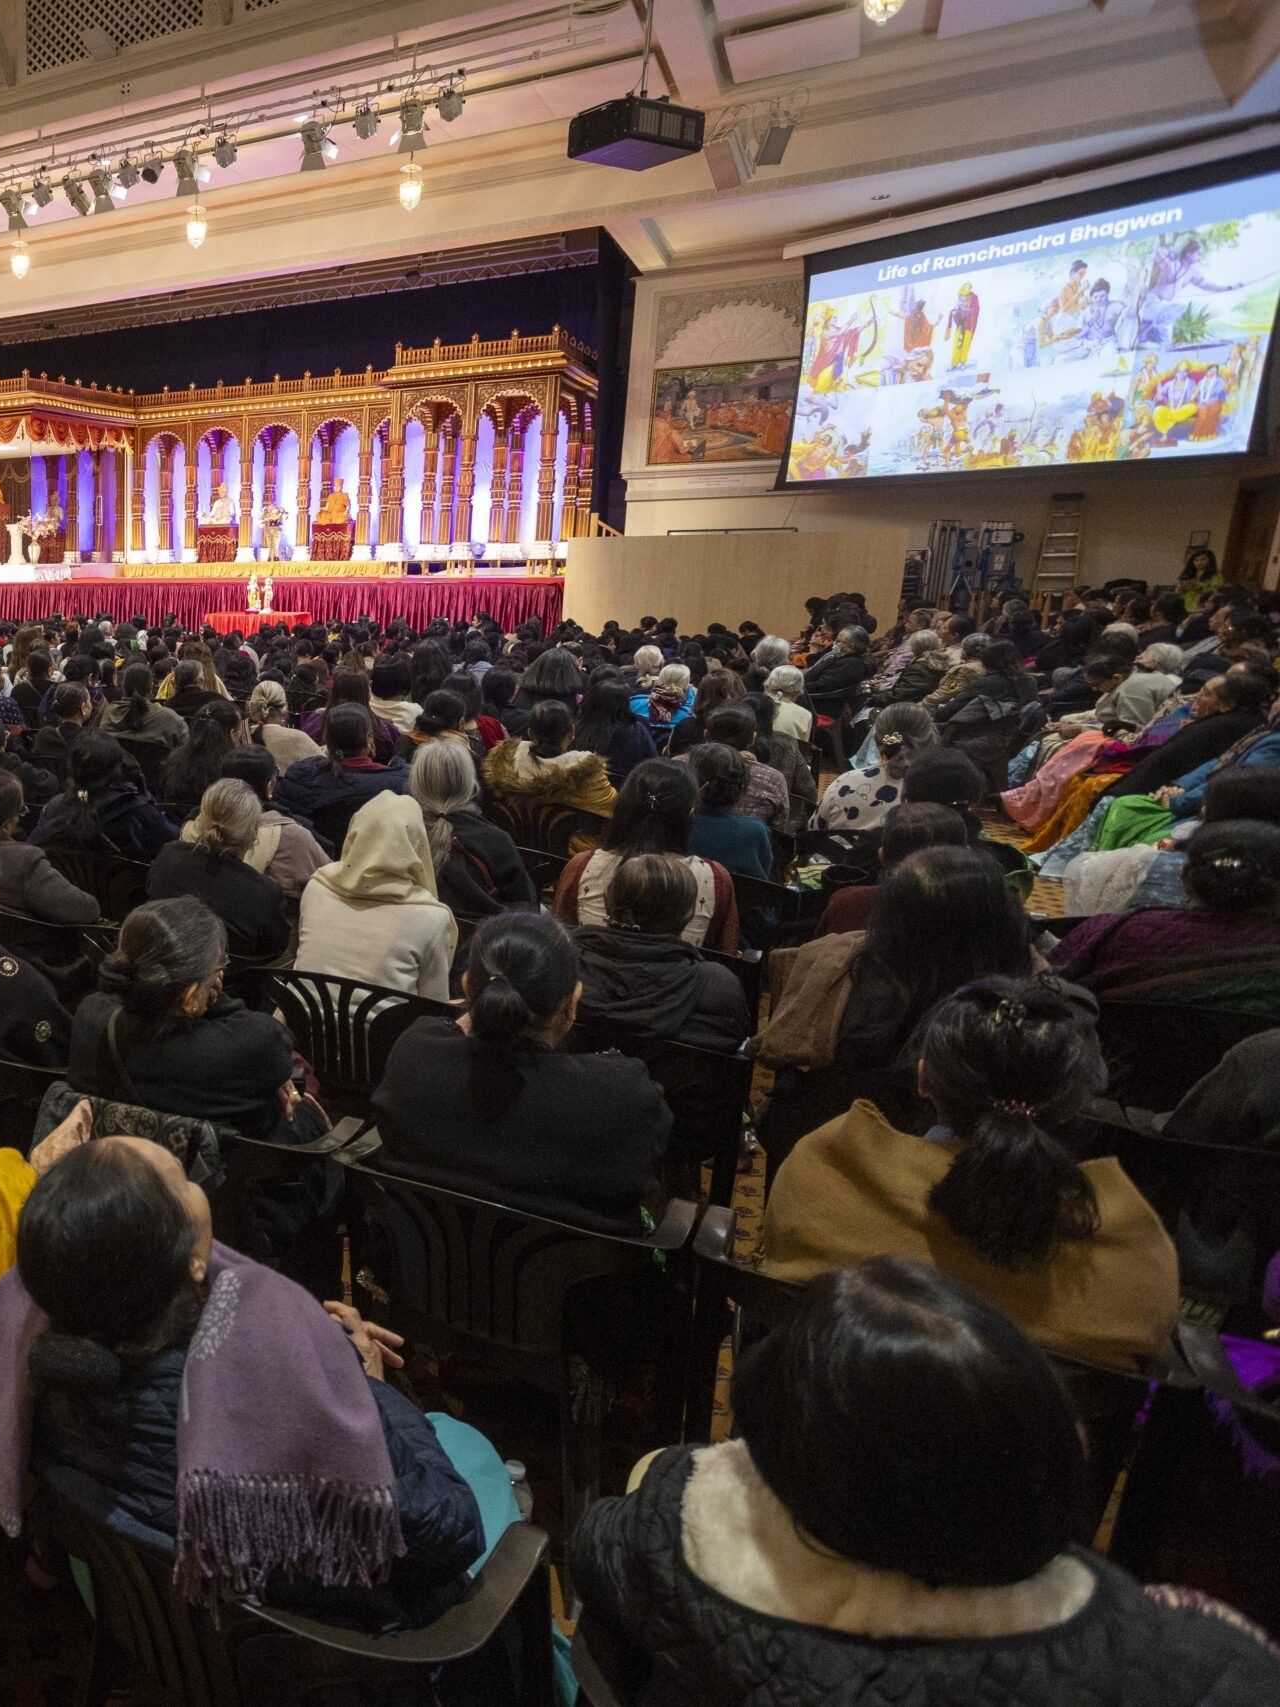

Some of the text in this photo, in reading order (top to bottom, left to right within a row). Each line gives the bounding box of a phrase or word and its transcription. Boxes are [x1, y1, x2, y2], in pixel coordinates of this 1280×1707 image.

[878, 207, 1183, 282] Life of Ramchandra Bhagwan
